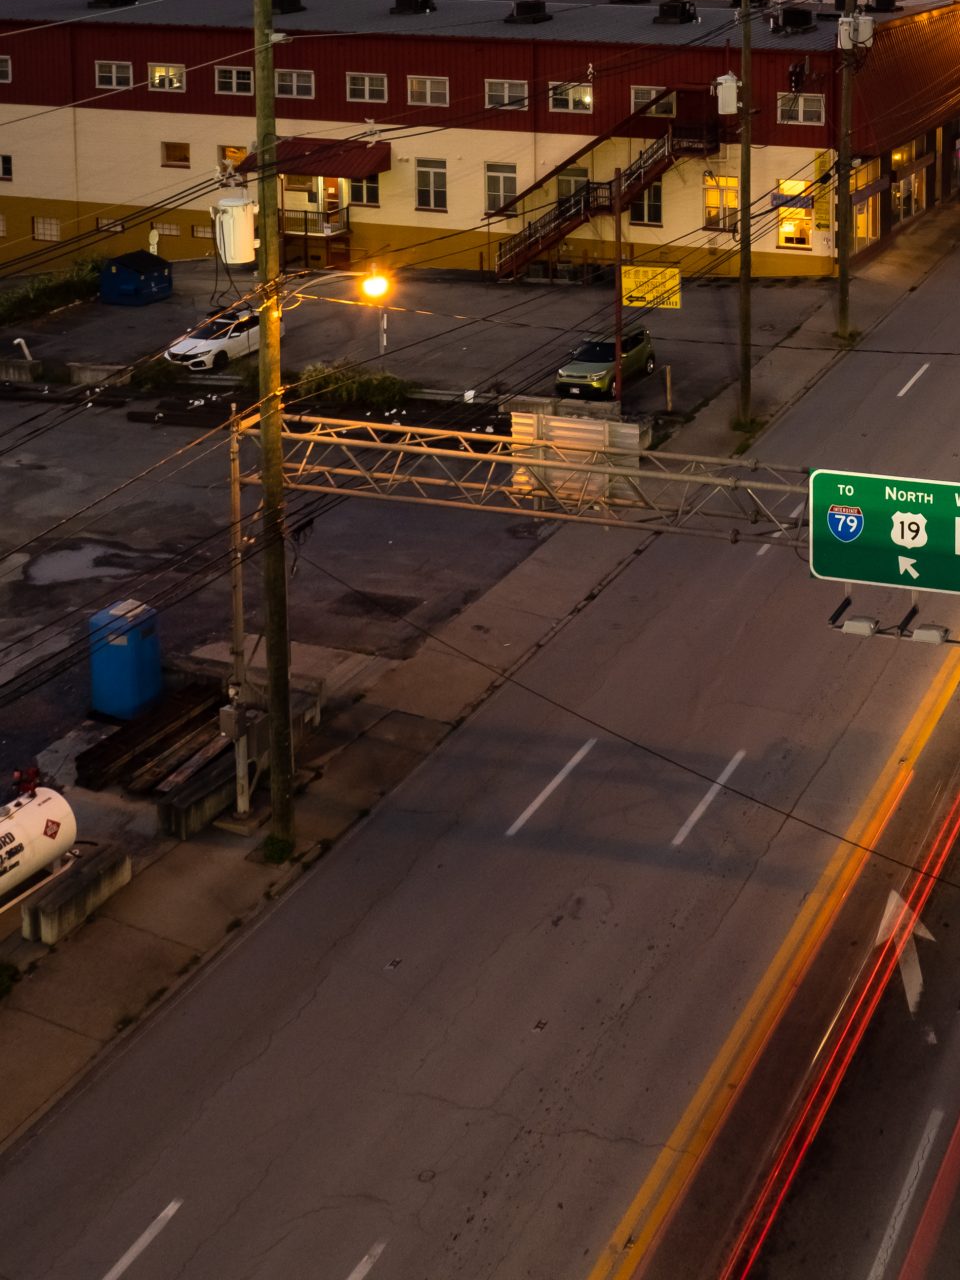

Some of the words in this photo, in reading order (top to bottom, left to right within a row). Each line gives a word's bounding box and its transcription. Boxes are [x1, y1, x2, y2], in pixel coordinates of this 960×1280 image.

[837, 484, 854, 496] TO
[885, 486, 933, 504] NORTH
[834, 515, 858, 533] 79
[899, 521, 920, 541] 19
